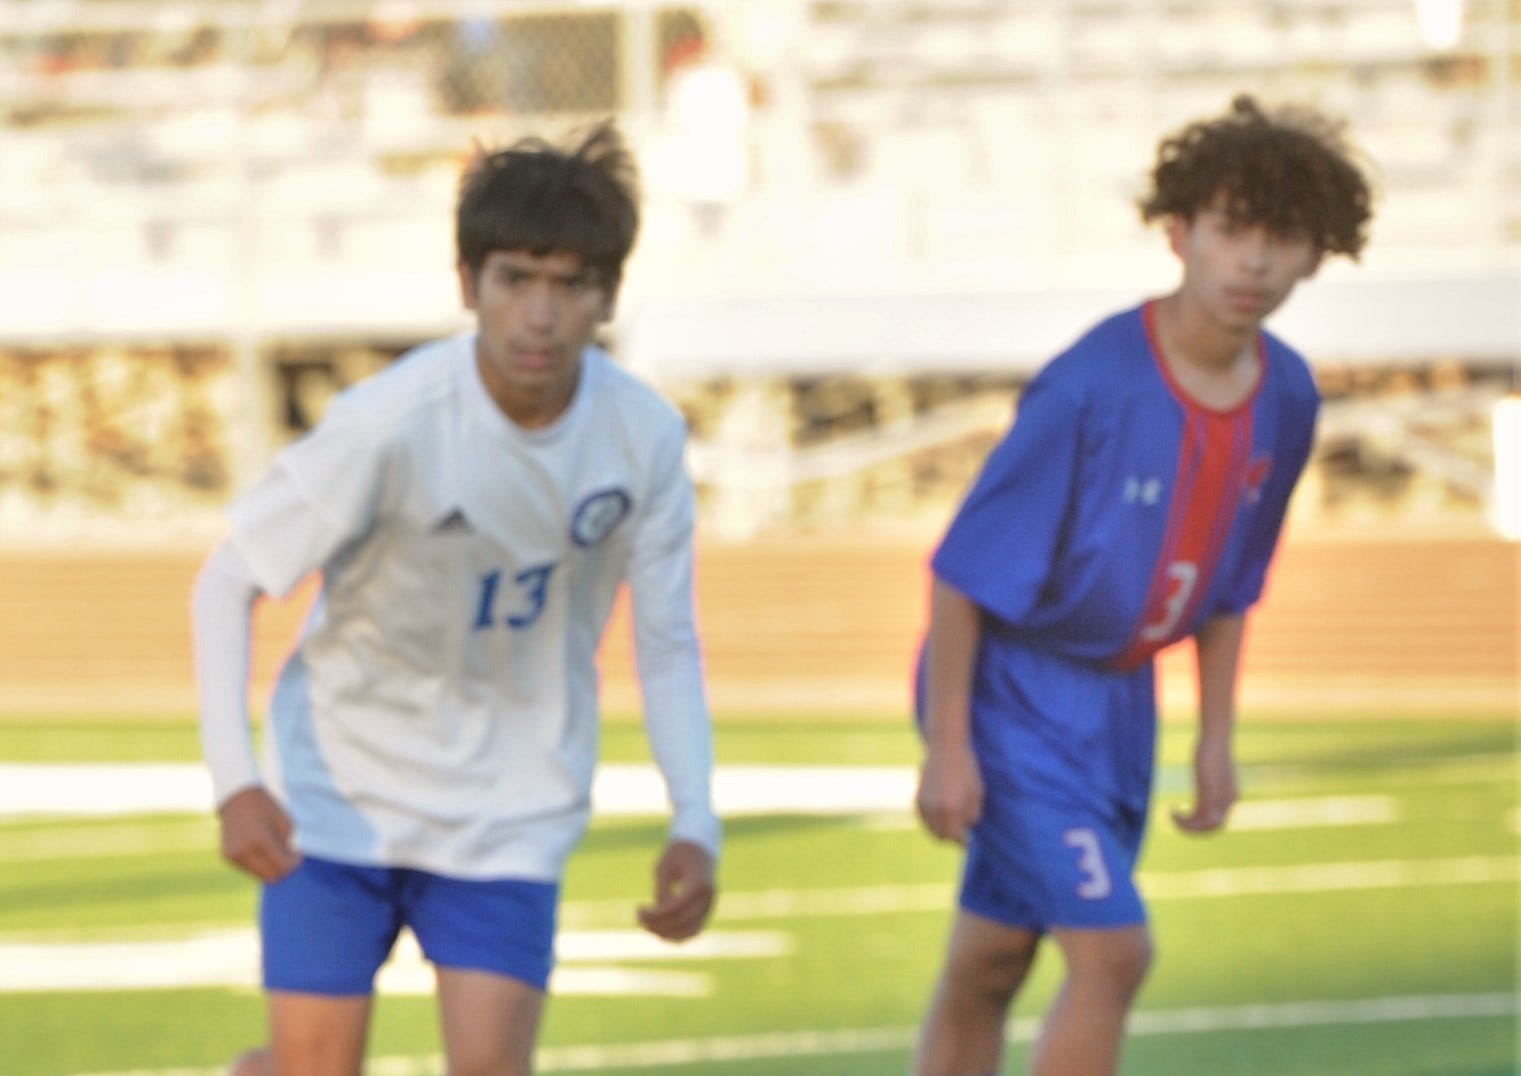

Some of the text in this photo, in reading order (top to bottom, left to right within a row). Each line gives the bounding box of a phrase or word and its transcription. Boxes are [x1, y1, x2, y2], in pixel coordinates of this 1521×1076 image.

[473, 562, 557, 631] 13
[1141, 561, 1199, 640] 3
[1064, 827, 1112, 899] 3
